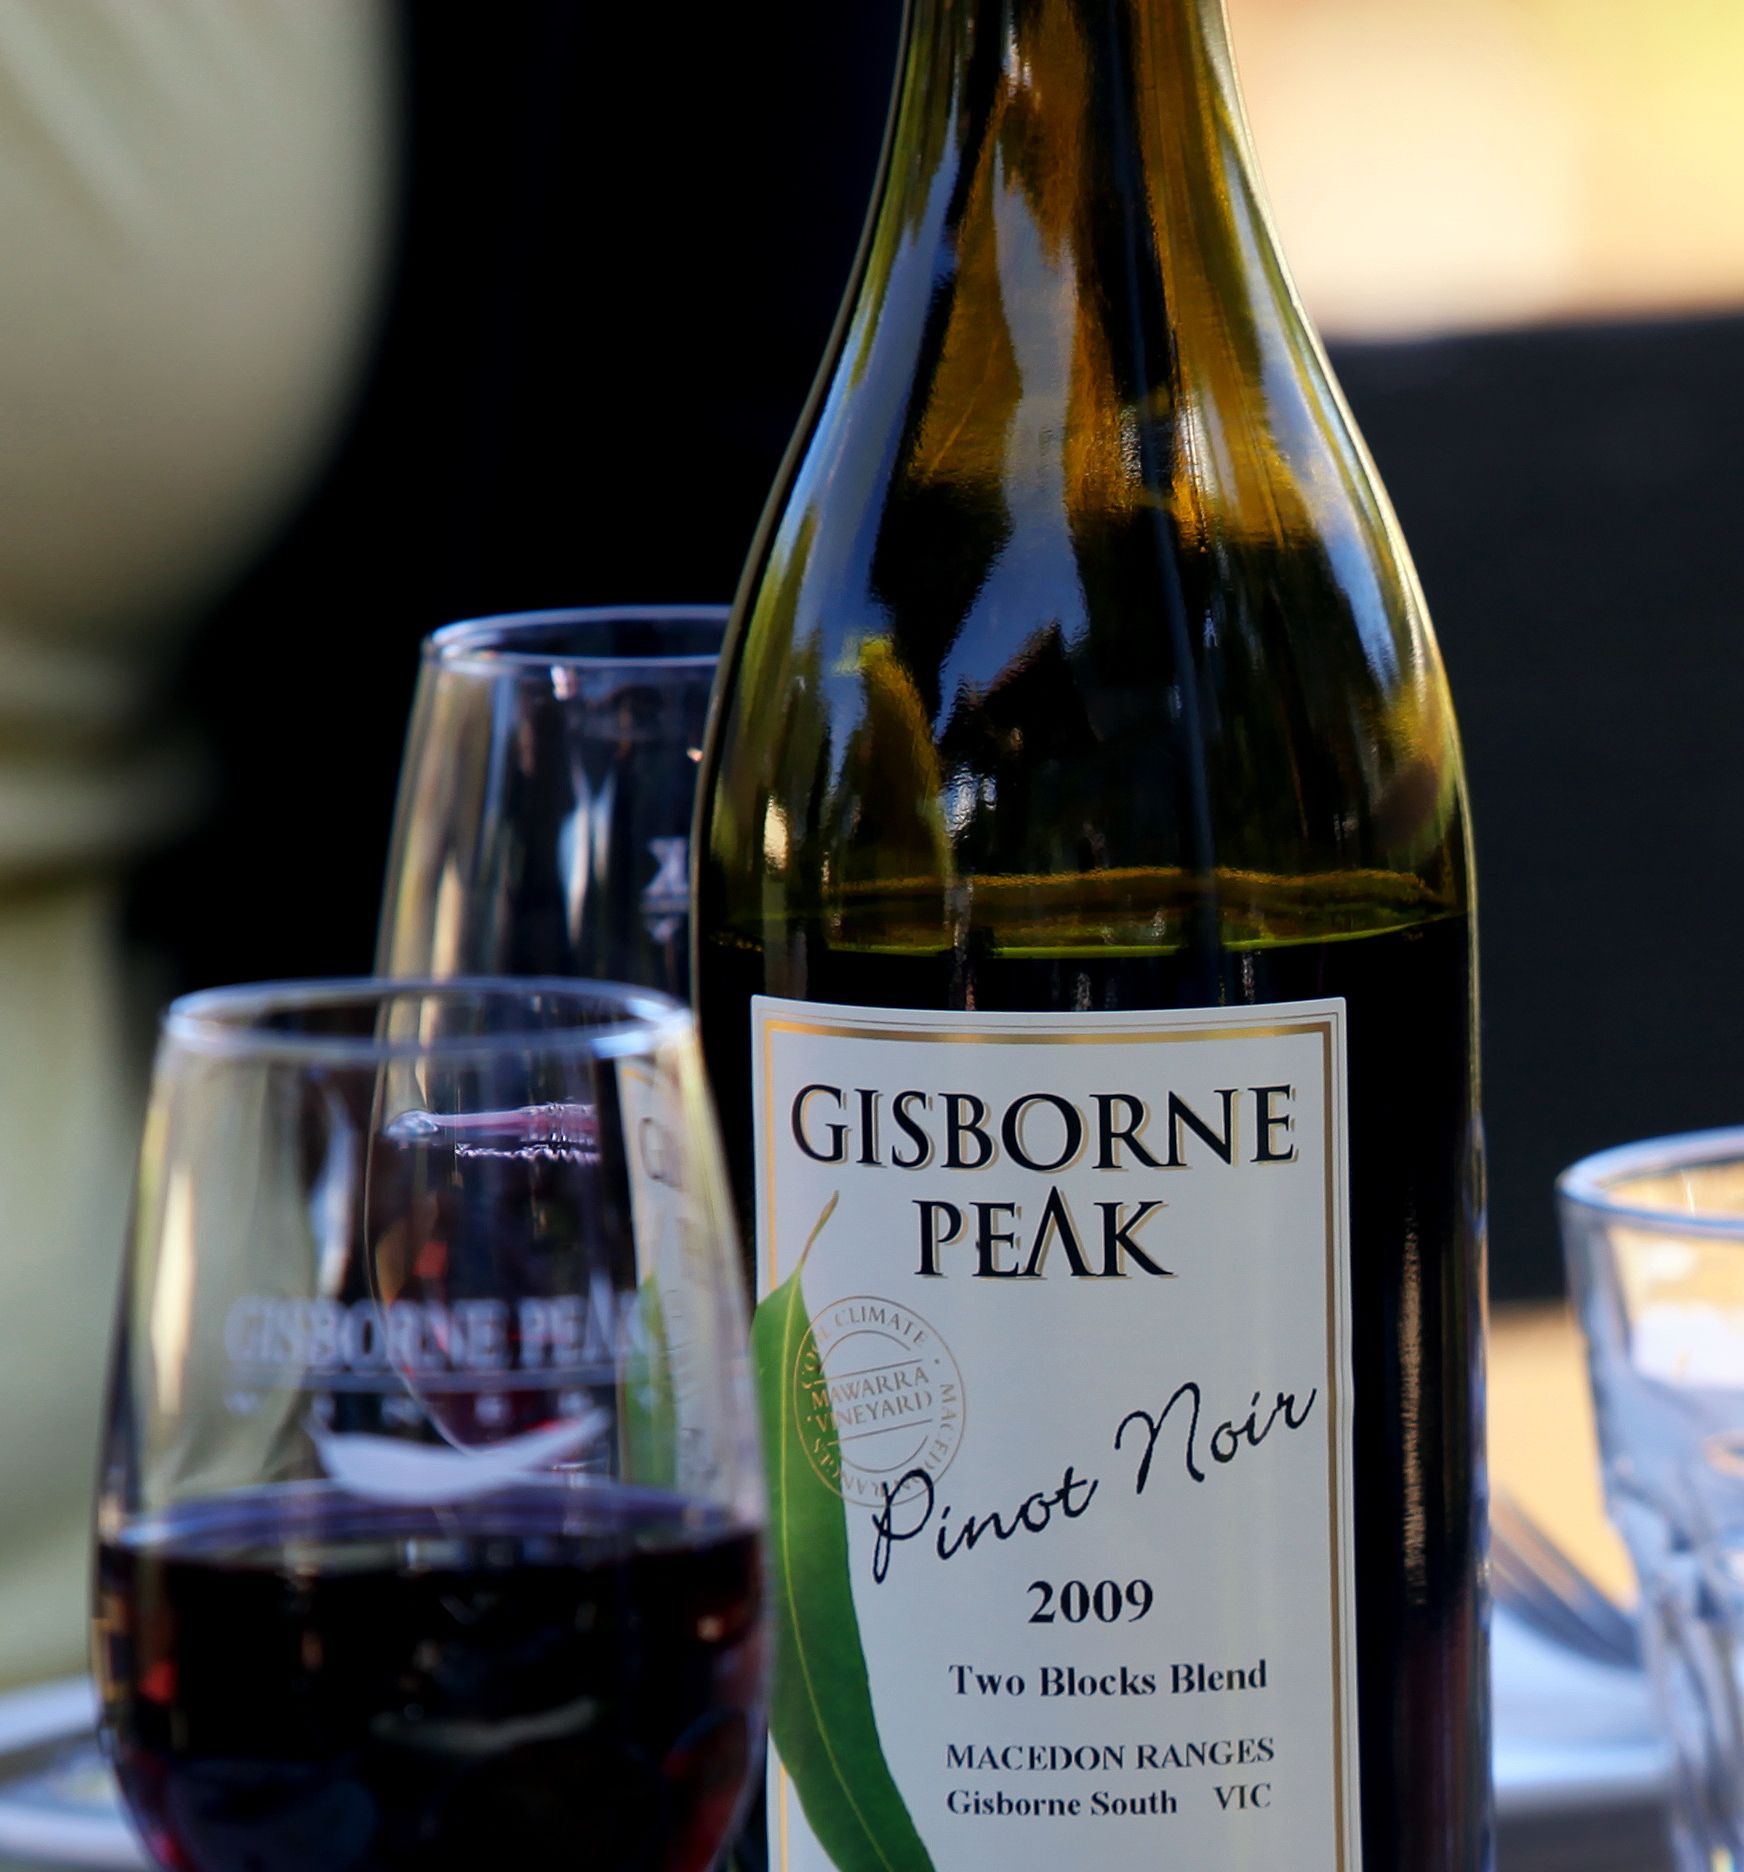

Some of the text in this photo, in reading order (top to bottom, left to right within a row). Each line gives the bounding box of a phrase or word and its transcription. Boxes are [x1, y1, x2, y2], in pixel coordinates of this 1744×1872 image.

[791, 1083, 1299, 1173] GISBORNE
[911, 1185, 1178, 1281] PEAK
[834, 1304, 929, 1347] CLIMATE
[810, 1365, 931, 1411] MAWARRA
[814, 1390, 934, 1434] VINEYARD
[871, 1381, 1318, 1584] Pinot Noir
[1026, 1579, 1154, 1624] 2009
[948, 1658, 1267, 1698] Two Blocks Blend
[946, 1737, 1275, 1771] MACEDON RANGES
[946, 1783, 1272, 1817] Gisborne South VIC
